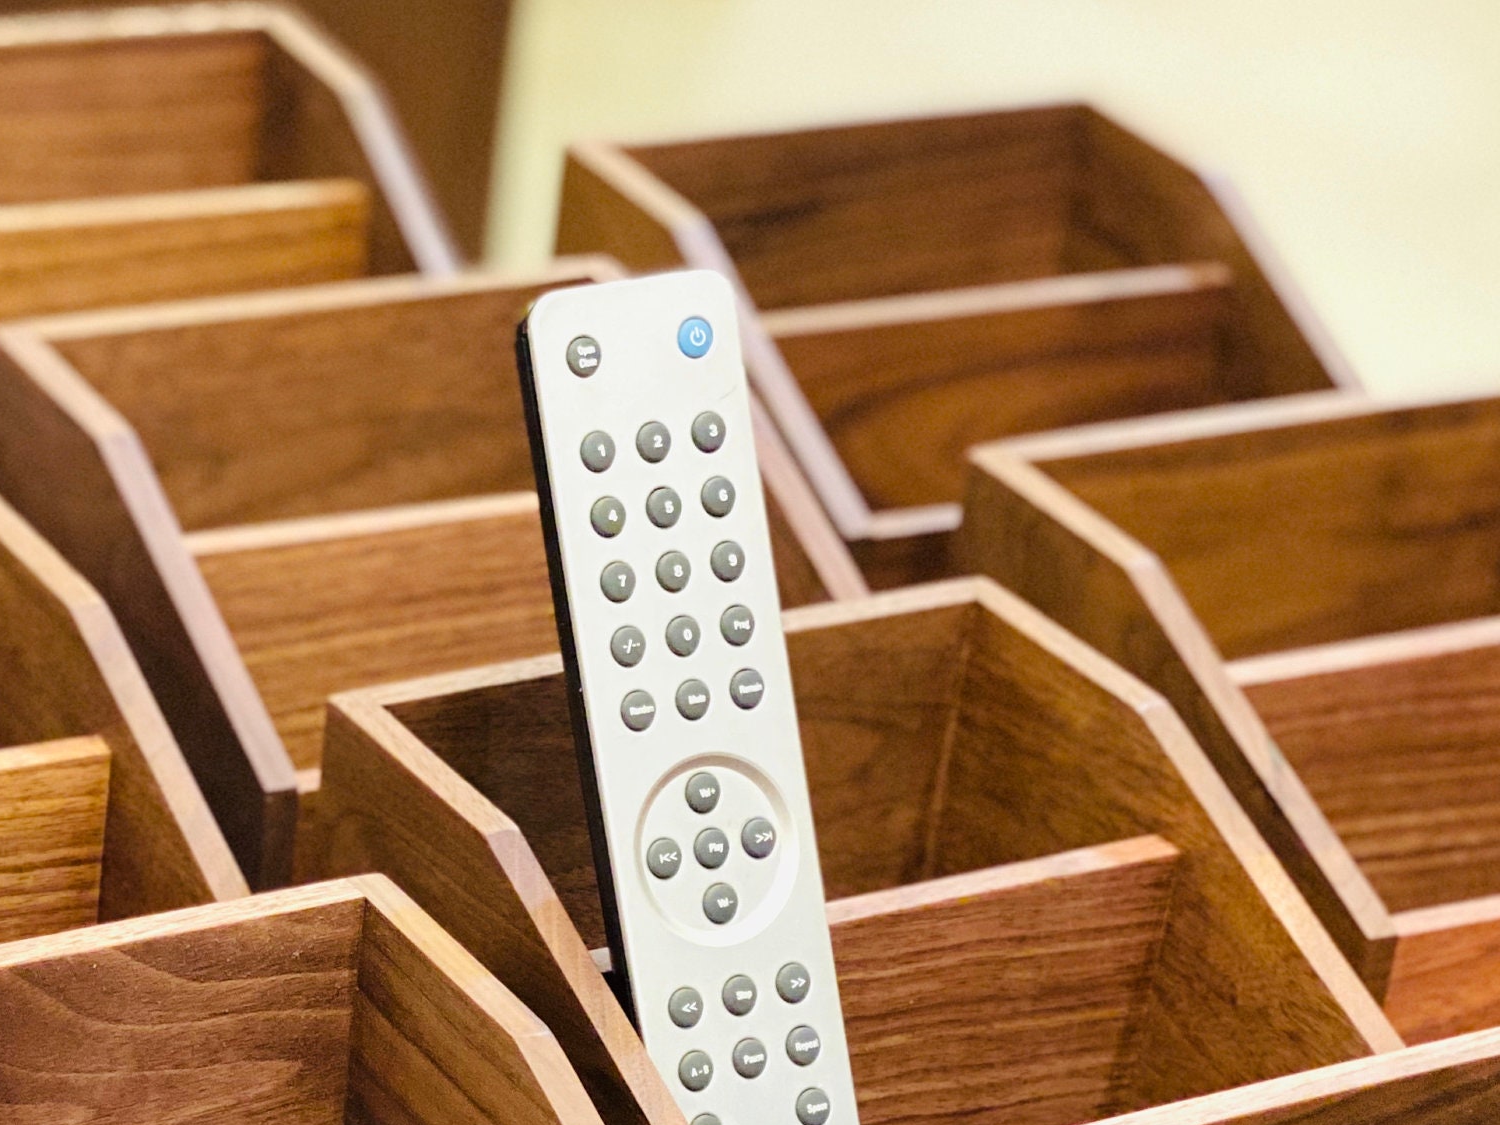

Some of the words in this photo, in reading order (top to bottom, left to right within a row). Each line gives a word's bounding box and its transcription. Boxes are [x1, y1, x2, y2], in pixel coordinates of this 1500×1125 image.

[597, 444, 606, 457] 1
[653, 435, 663, 448] 2
[709, 424, 718, 437] 3
[608, 509, 618, 522] 4
[664, 500, 674, 514] 5
[719, 489, 729, 501] 6
[618, 574, 627, 587] 7
[673, 565, 683, 578] 8
[728, 553, 738, 566] 9
[683, 628, 693, 641] 0
